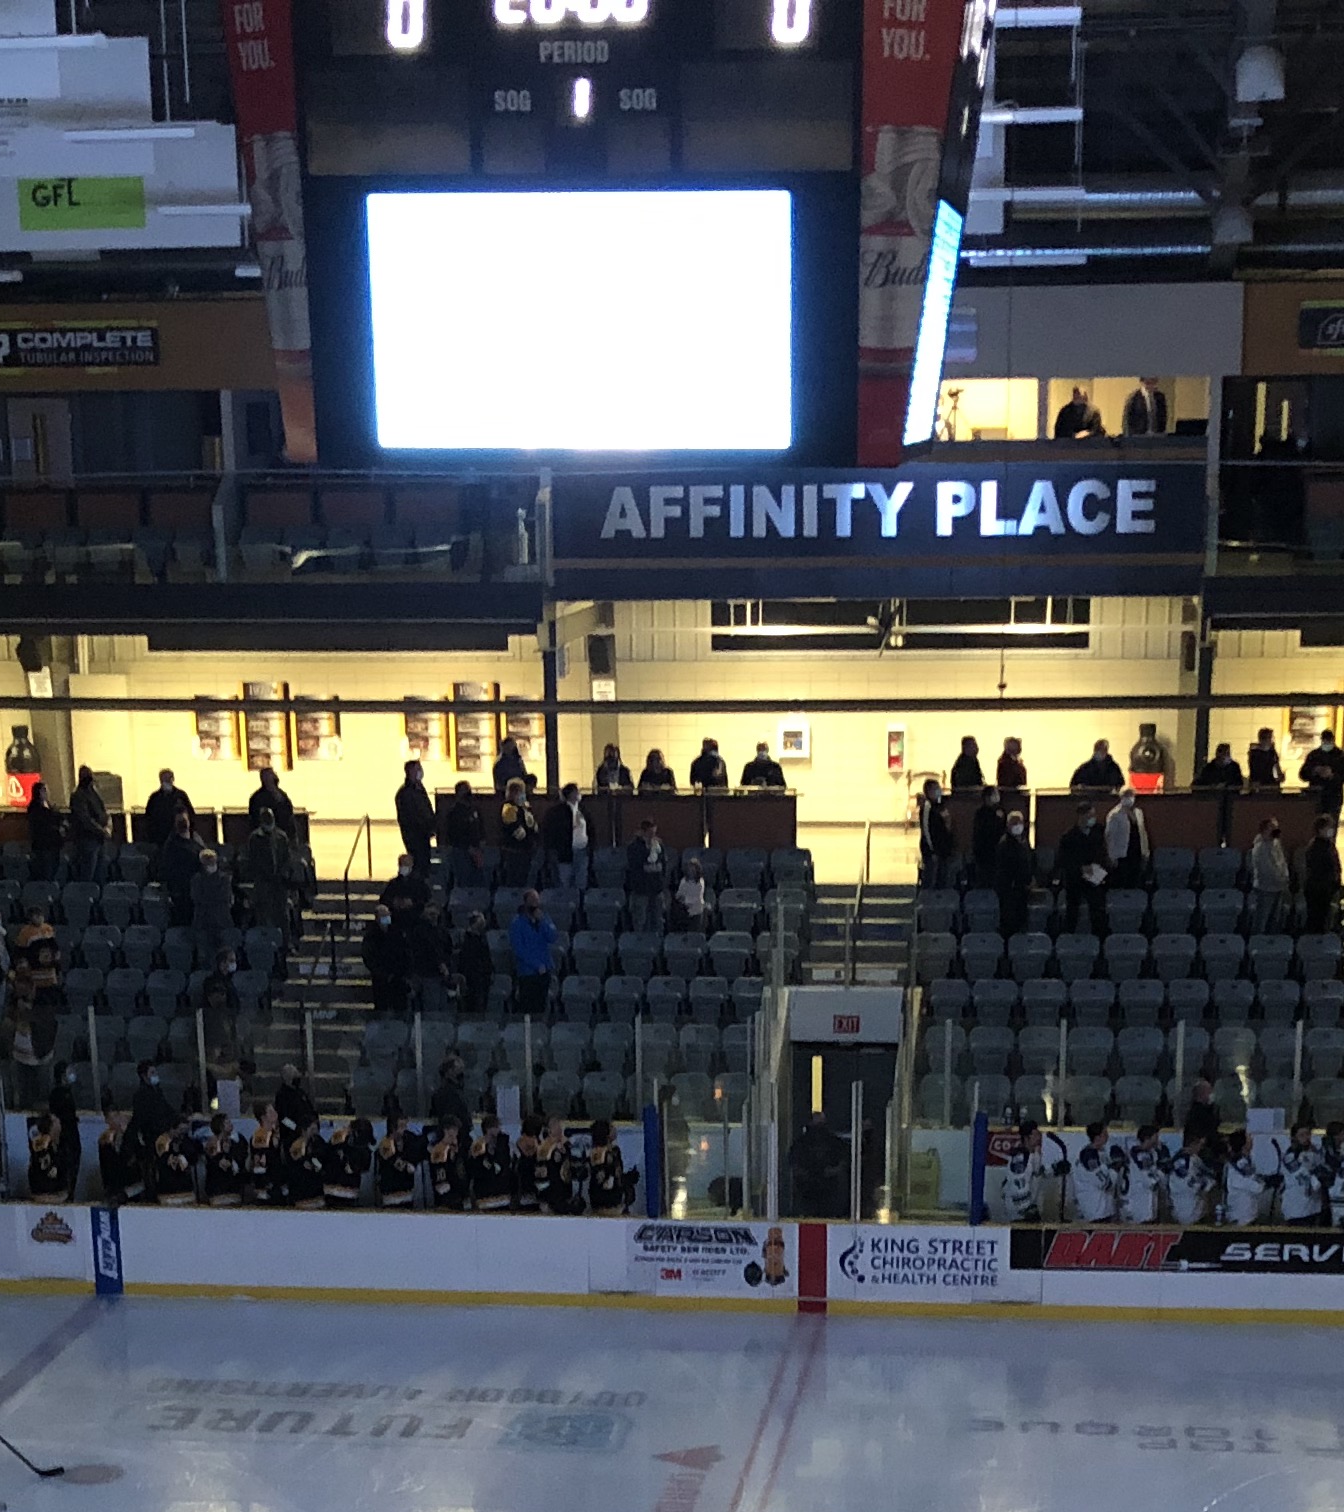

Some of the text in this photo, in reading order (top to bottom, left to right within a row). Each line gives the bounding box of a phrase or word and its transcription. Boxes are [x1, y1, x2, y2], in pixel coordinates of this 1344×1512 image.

[234, 2, 264, 34] FOR
[539, 41, 609, 63] PERIOD
[881, 28, 930, 61] YOU.
[494, 89, 531, 112] SOG
[619, 87, 657, 111] SOG
[17, 330, 153, 348] COMPLETE
[80, 350, 154, 363] INSPECTION
[600, 480, 1157, 538] AFFINITY PLACE
[836, 1016, 859, 1031] EXIT
[634, 1224, 759, 1246] CARSON
[642, 1245, 678, 1254] SAFETY
[871, 1237, 998, 1257] KING STREET
[1043, 1230, 1185, 1272] DART
[660, 1268, 682, 1280] 3M
[870, 1256, 998, 1273] CHIROPRACTIC
[942, 1274, 999, 1287] CENTRE
[147, 1406, 476, 1441] FUTURE
